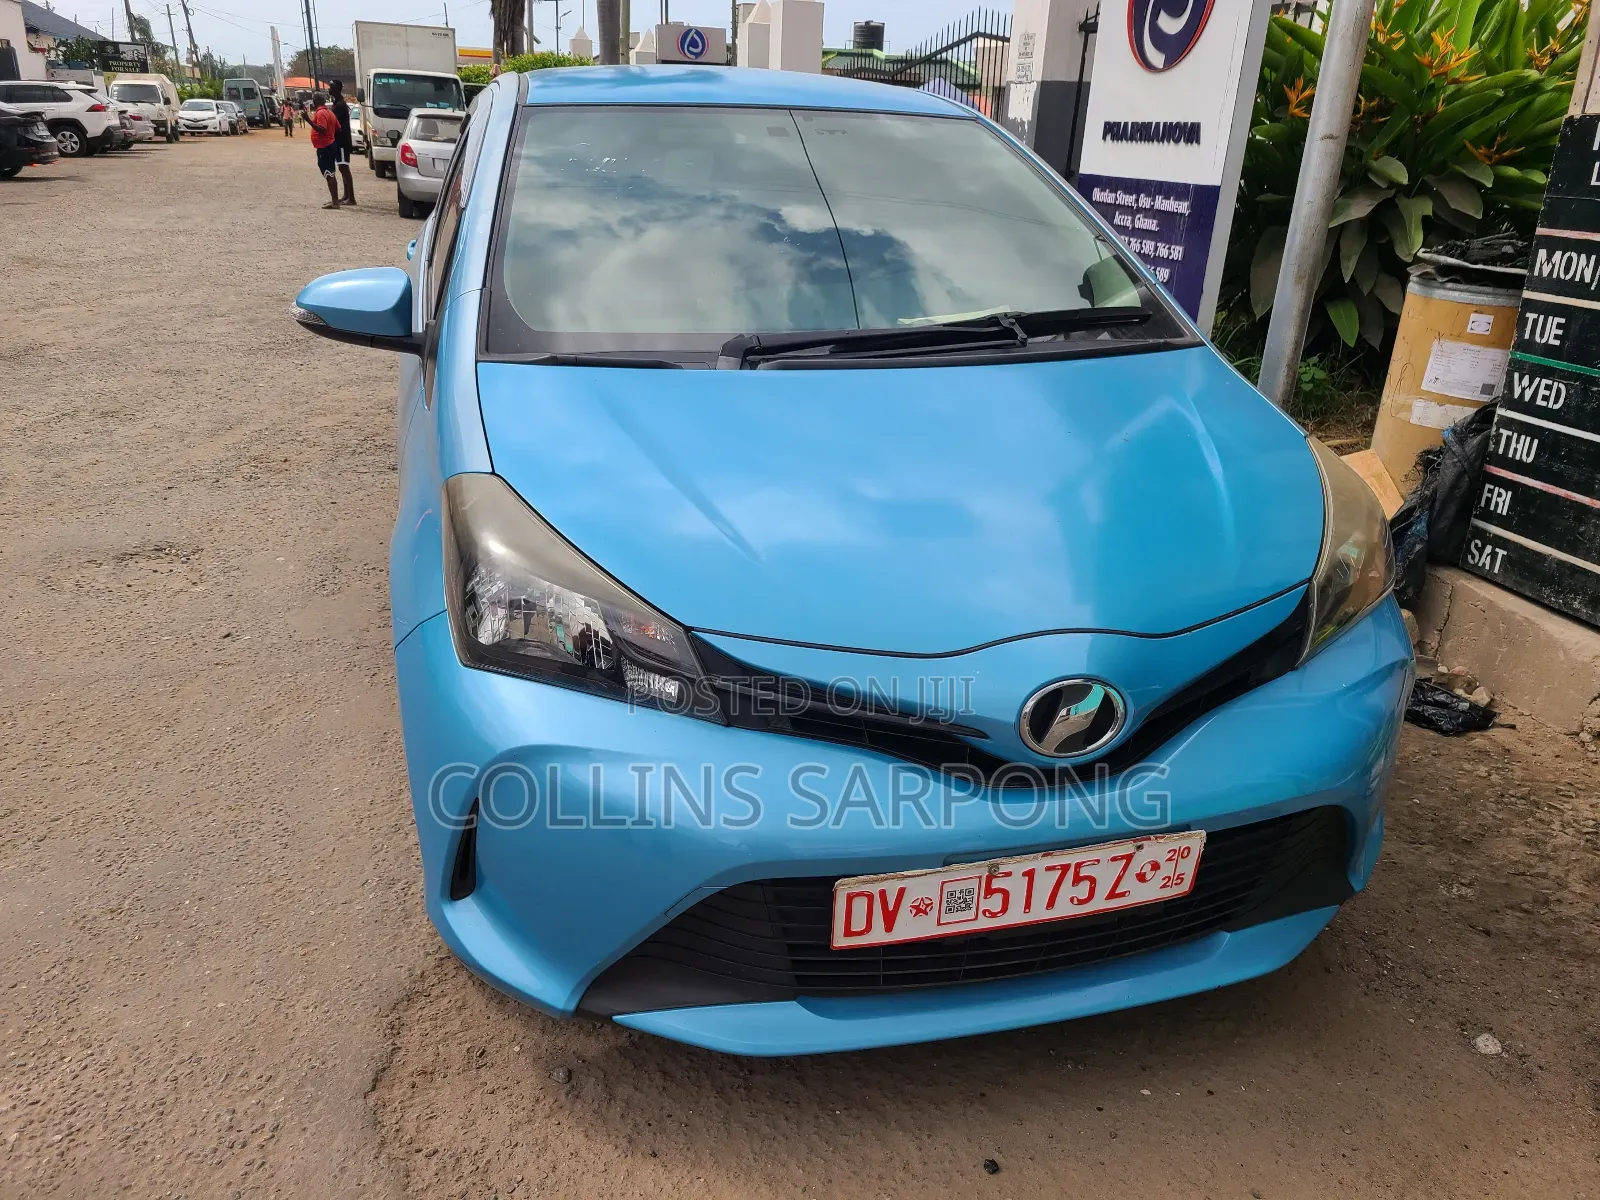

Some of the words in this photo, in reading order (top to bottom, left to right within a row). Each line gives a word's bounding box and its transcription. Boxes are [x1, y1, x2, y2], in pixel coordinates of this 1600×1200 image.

[1113, 211, 1132, 230] Accra,
[1524, 312, 1566, 346] TUE
[1513, 372, 1567, 410] WED
[1498, 427, 1539, 464] THU
[1479, 482, 1513, 516] FRI
[1467, 539, 1508, 574] SAT
[843, 886, 906, 938] DV
[981, 852, 1136, 920] 5175Z
